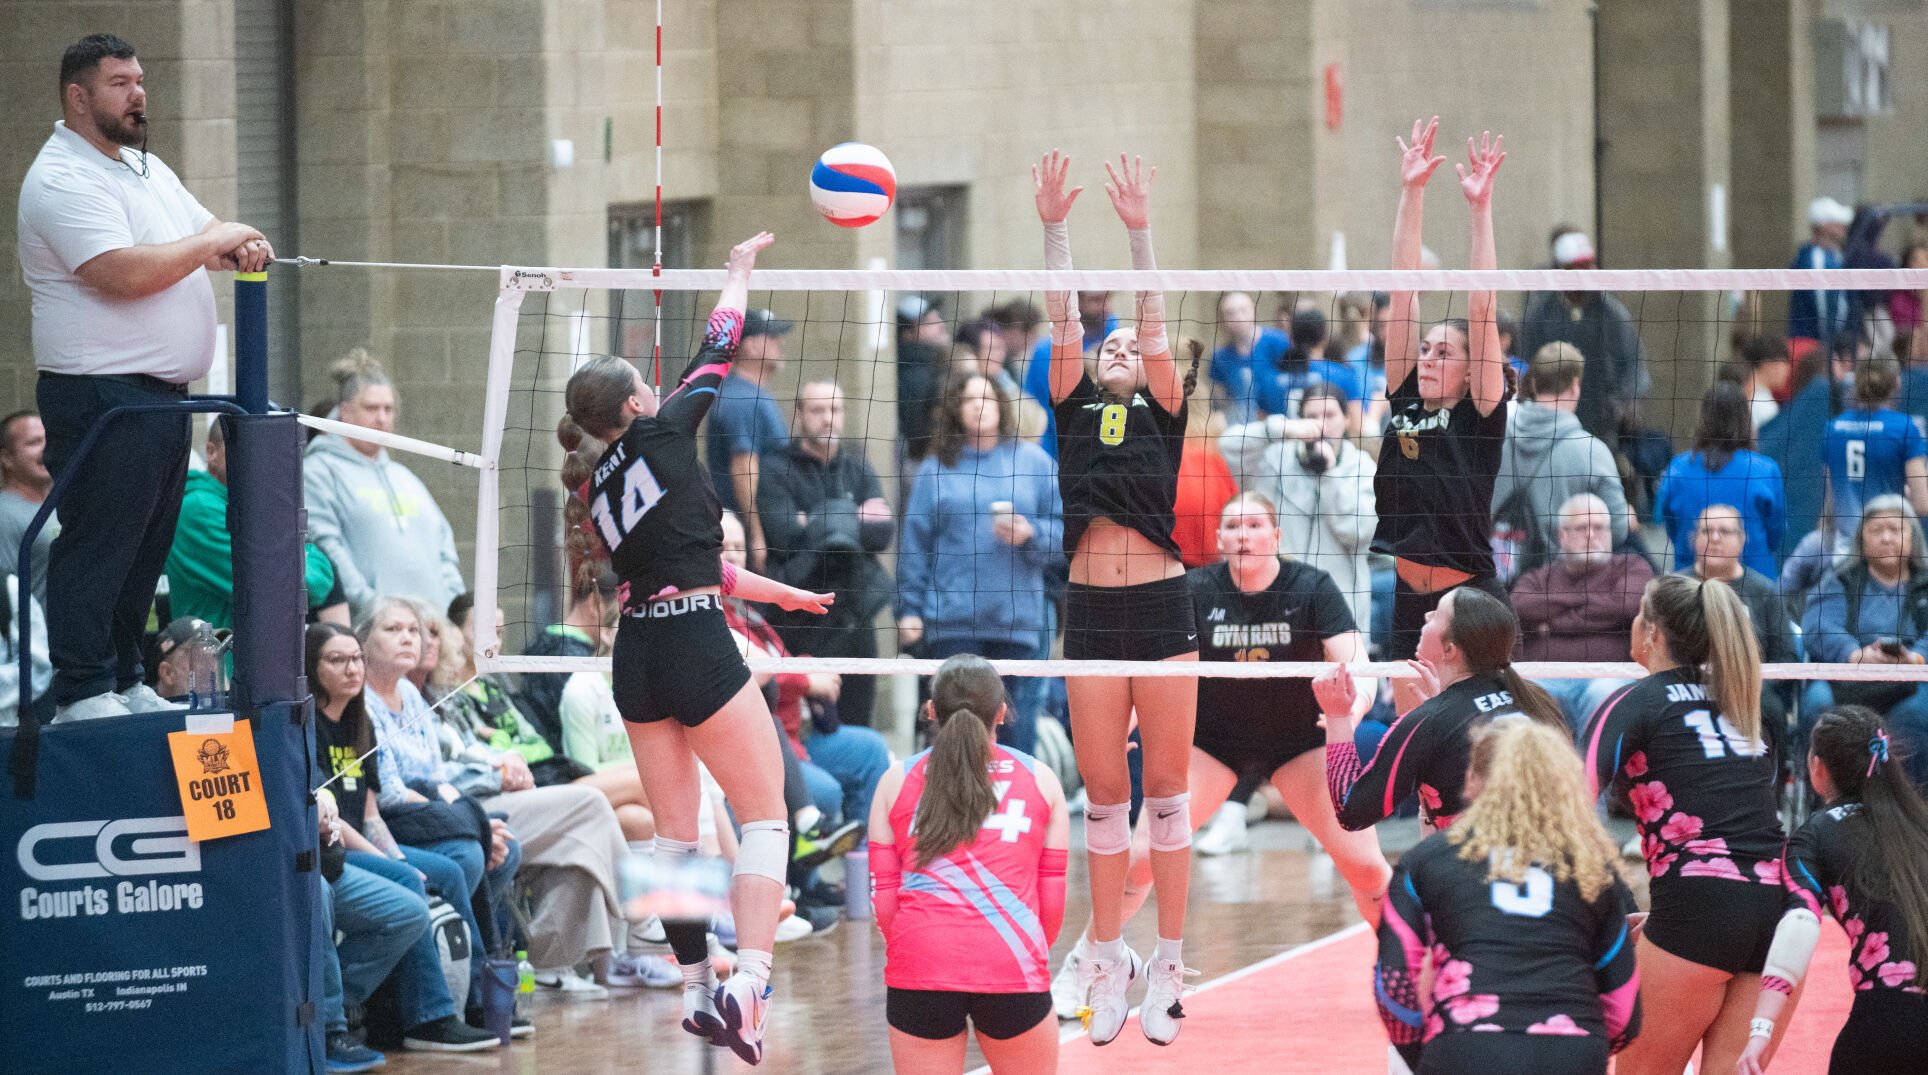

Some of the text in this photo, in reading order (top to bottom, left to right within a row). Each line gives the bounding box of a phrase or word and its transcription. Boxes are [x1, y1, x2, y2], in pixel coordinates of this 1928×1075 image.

[1099, 404, 1128, 446] 8
[594, 441, 627, 487] KENT
[1846, 440, 1866, 481] 6
[591, 456, 668, 552] 14
[189, 771, 251, 801] COURT
[212, 799, 236, 821] 18
[20, 880, 203, 920] Courts Galore
[24, 965, 208, 987] COURTS AND FLOORING FOR ALL SPORTS
[116, 982, 188, 996] Indianapolis IN
[49, 988, 95, 1000] Austin TX
[85, 999, 153, 1013] 512-797-0567
